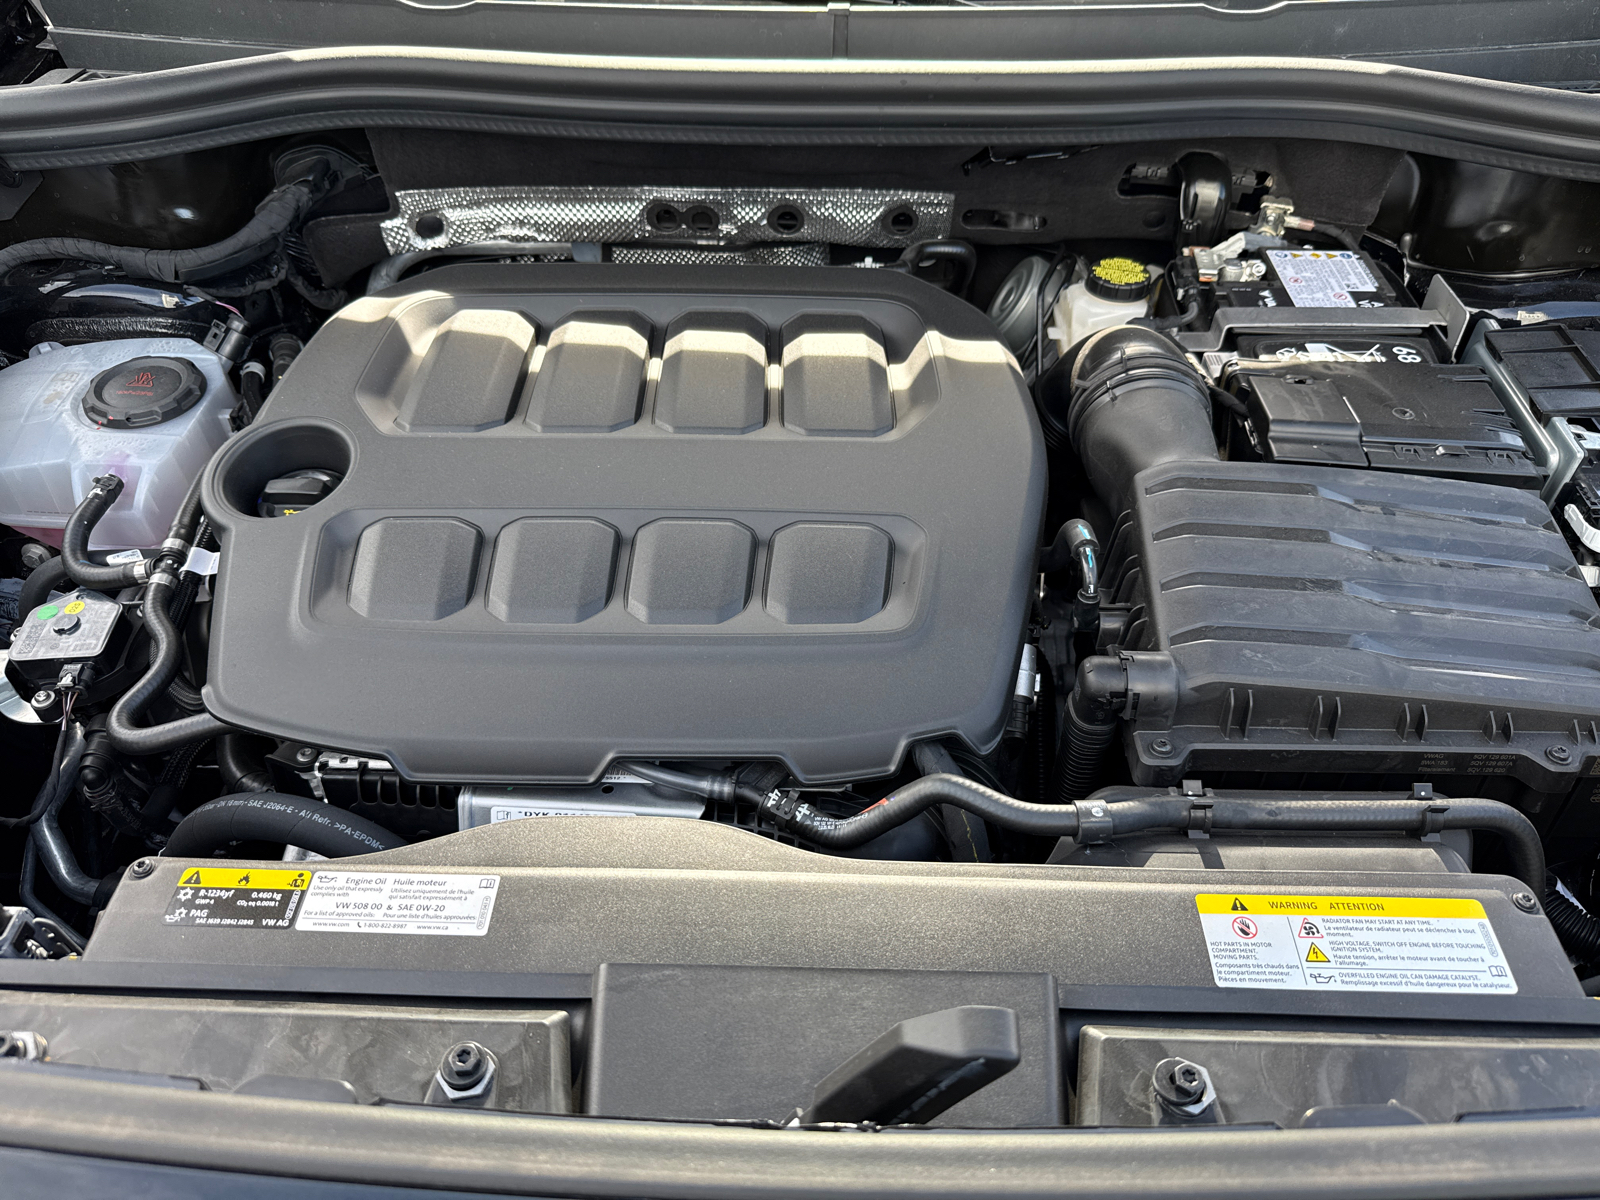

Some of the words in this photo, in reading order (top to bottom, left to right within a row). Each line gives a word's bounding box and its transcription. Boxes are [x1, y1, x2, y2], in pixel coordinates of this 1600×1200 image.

[263, 802, 294, 814] J2064-E
[312, 814, 331, 826] Refr.
[346, 877, 373, 886] Engine
[199, 889, 235, 899] R-1234yf
[1268, 901, 1318, 909] WARNING
[1329, 902, 1384, 911] ATTENTION
